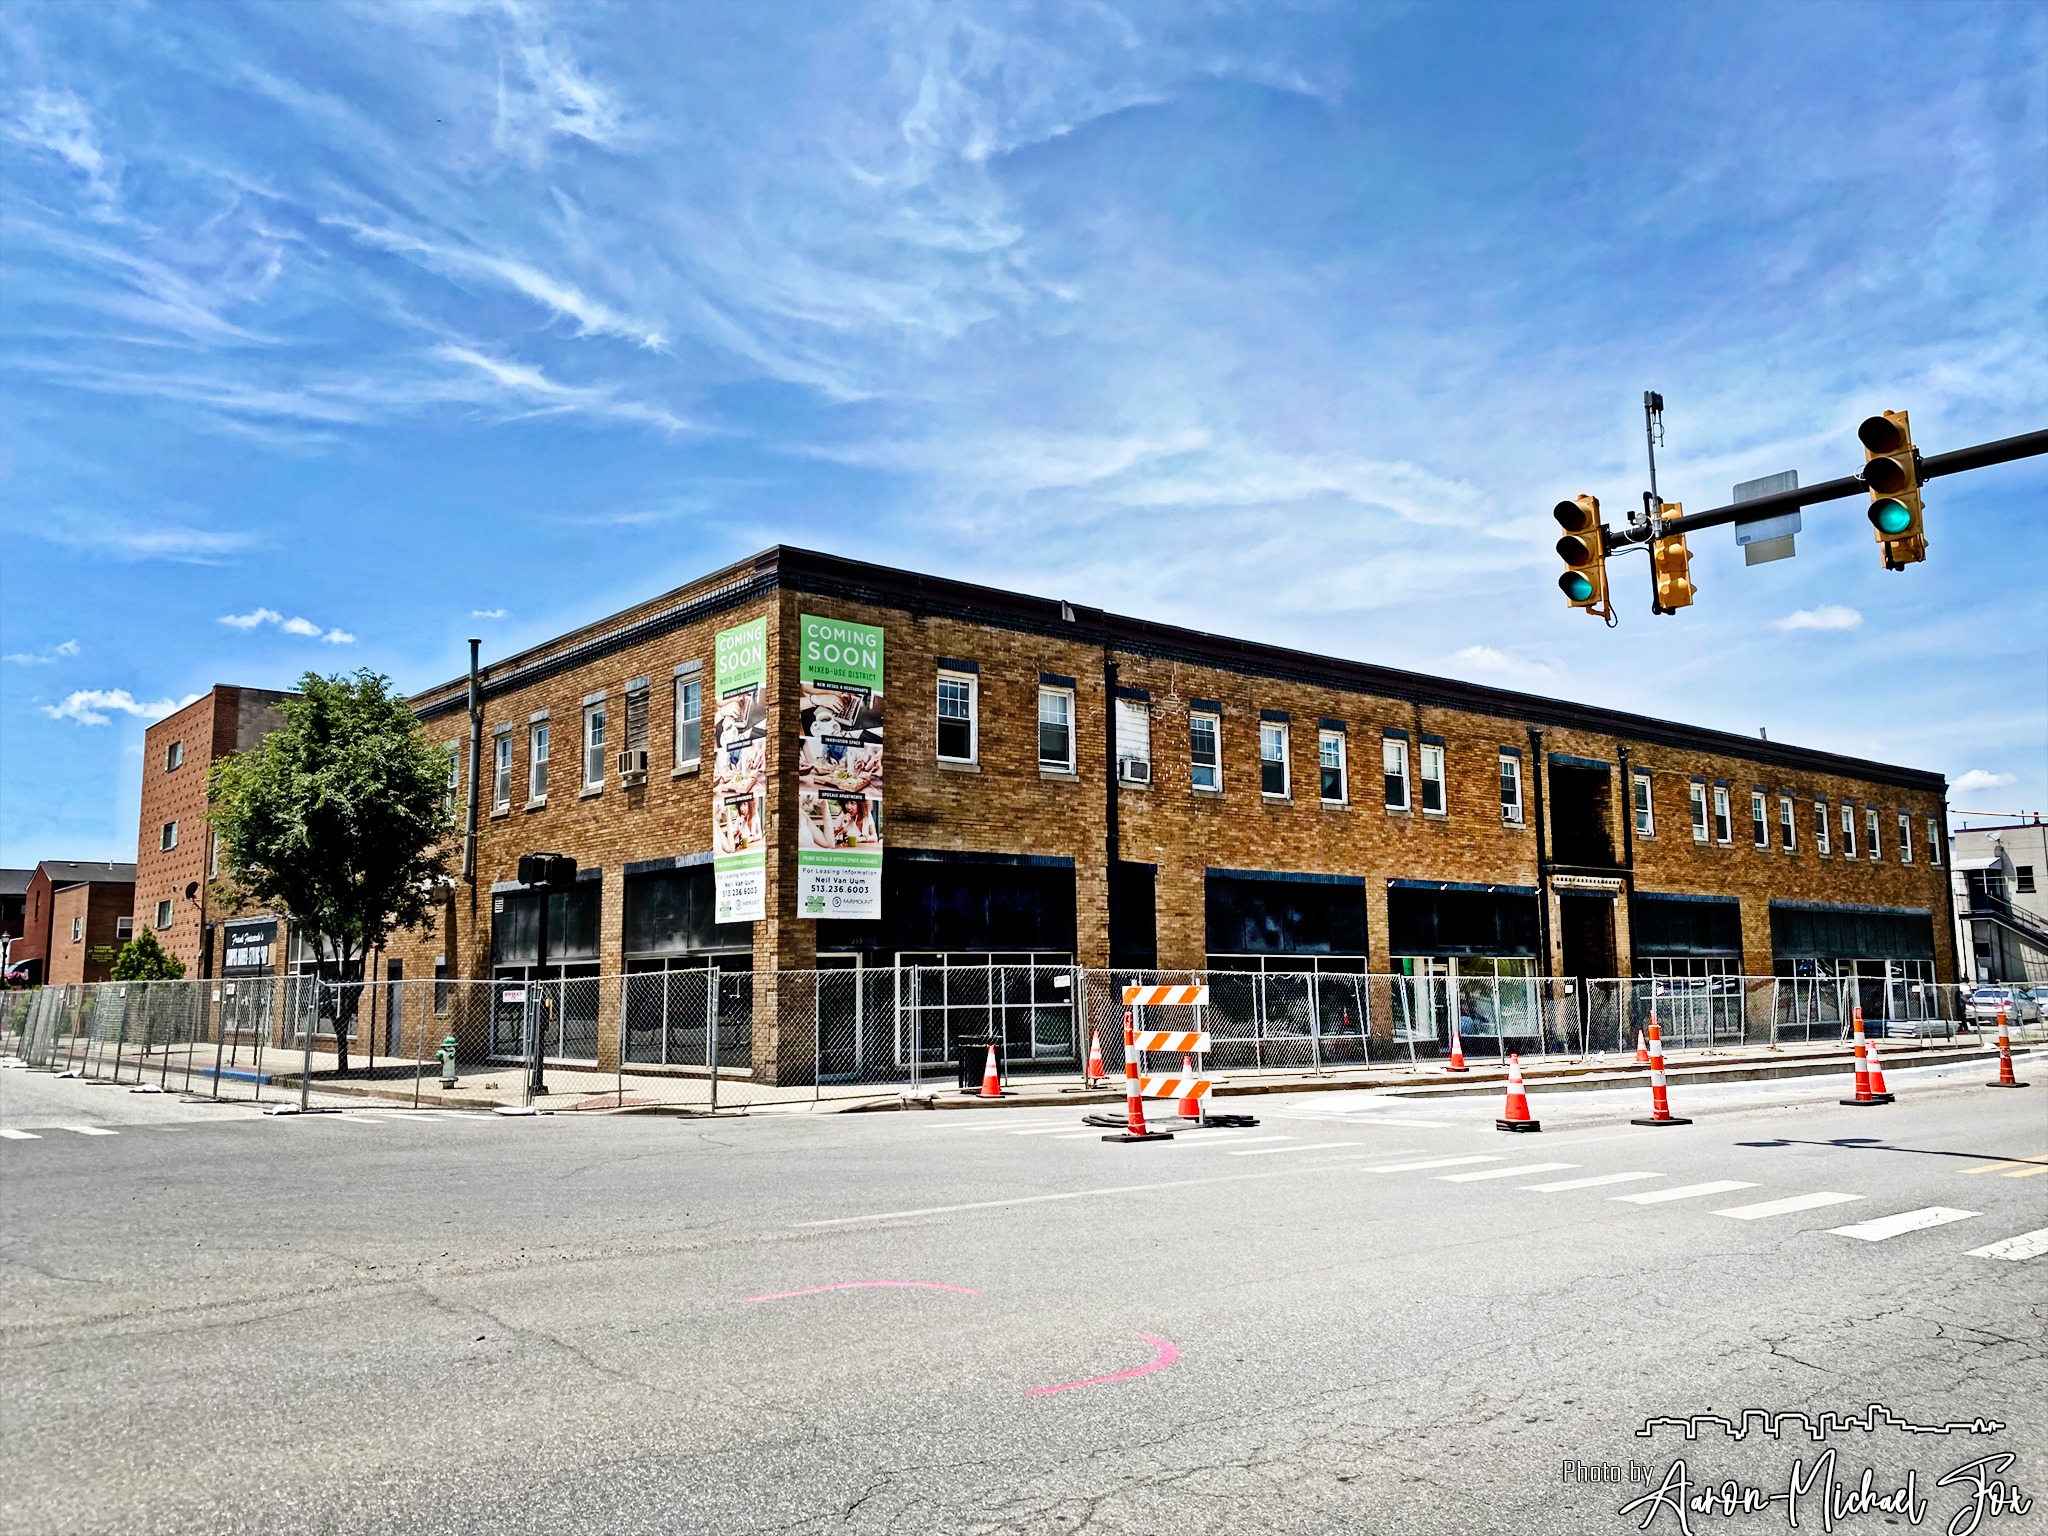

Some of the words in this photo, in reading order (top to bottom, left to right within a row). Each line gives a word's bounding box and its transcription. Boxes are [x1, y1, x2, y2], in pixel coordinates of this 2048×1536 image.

[719, 626, 762, 652] COMING
[807, 623, 877, 648] COMING
[719, 643, 762, 674] SOON
[807, 640, 877, 670] SOON
[808, 664, 846, 677] MIXED-USE
[847, 670, 877, 681] DISTRICT
[815, 868, 840, 876] Leasing
[815, 876, 831, 884] Neil
[811, 885, 869, 894] 513.236.6003
